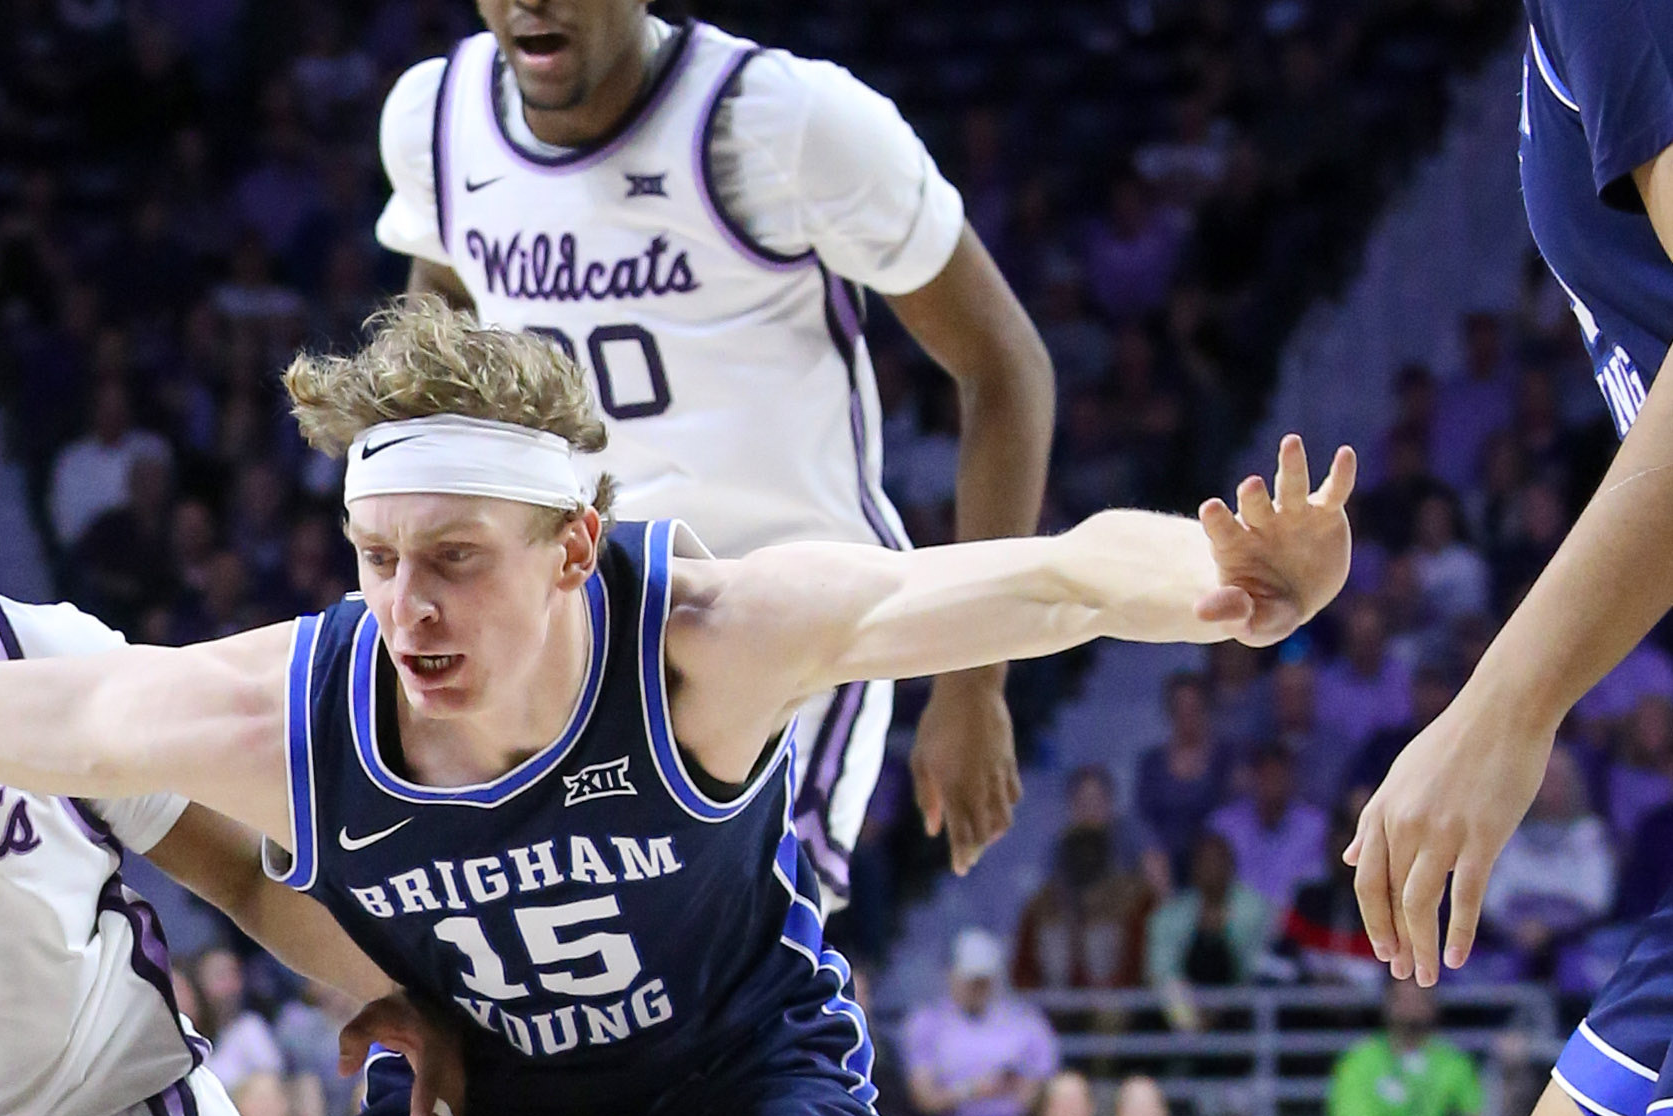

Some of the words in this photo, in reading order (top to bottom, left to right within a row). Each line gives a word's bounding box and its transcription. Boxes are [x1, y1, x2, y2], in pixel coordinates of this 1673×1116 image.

[466, 229, 702, 301] Wildcats
[523, 323, 673, 421] 0
[348, 834, 683, 918] BRIGHAM
[433, 894, 643, 1000] 15
[453, 977, 674, 1057] YOUNG
